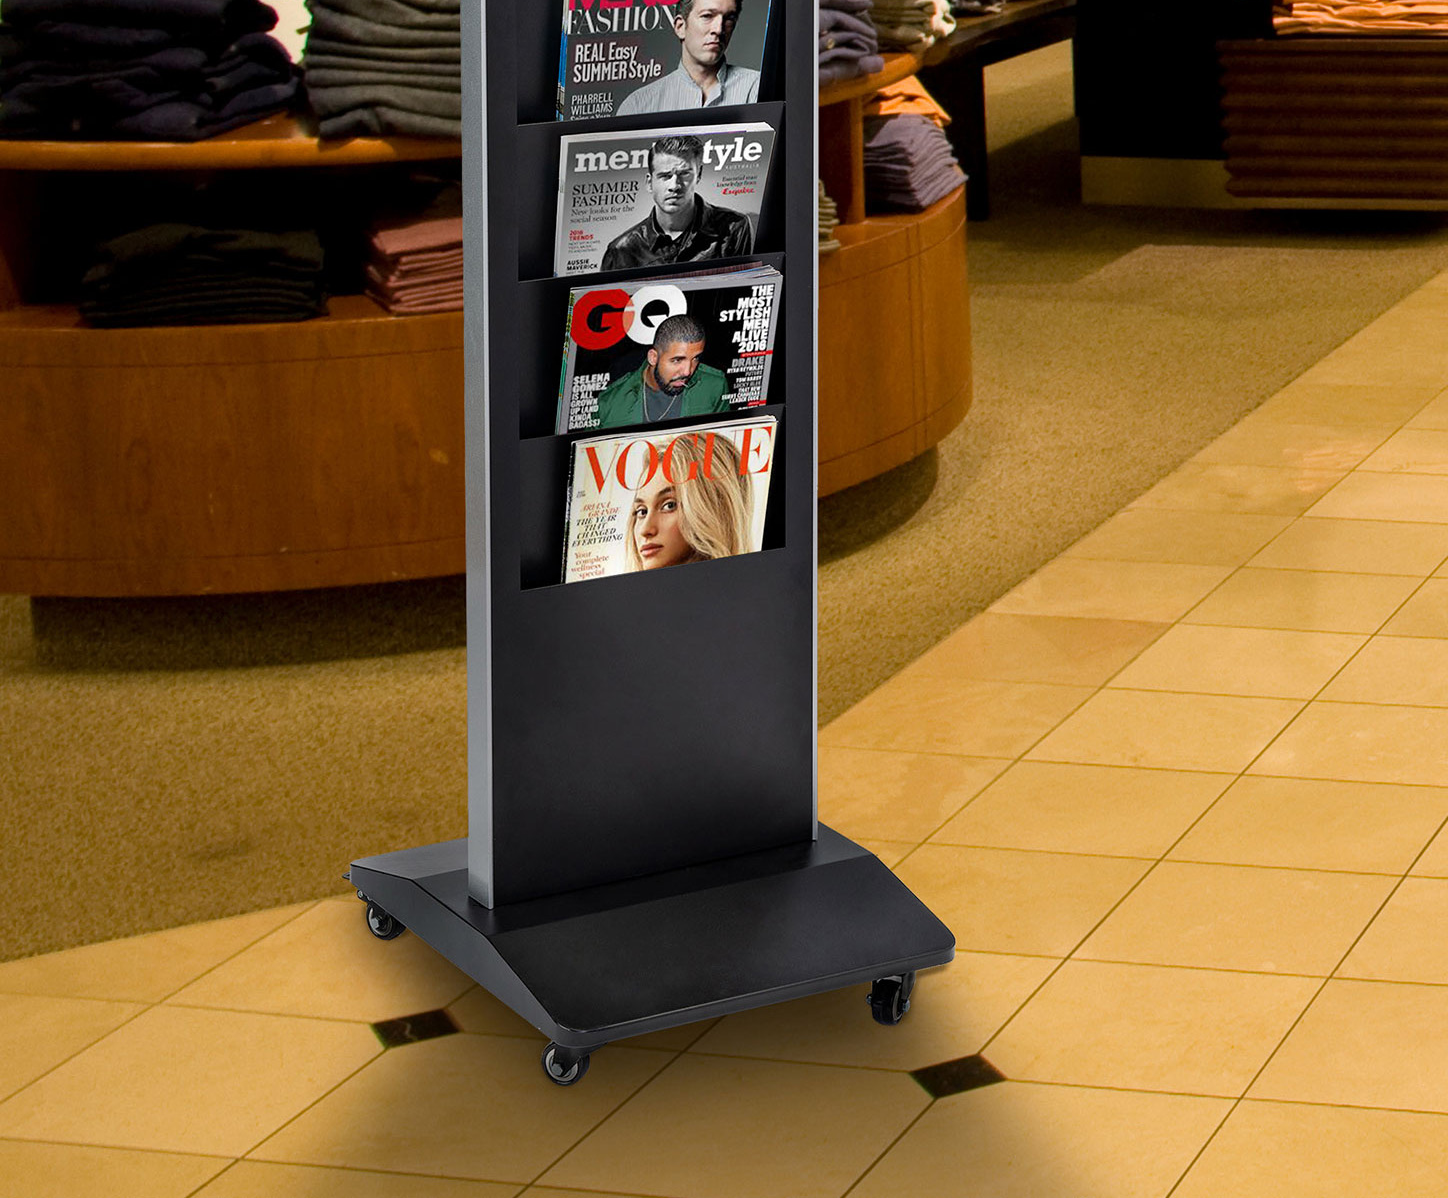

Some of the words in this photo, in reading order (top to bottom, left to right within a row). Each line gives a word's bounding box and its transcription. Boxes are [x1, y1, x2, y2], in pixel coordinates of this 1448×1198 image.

[567, 4, 678, 35] FASHION
[575, 42, 606, 63] REAL
[608, 42, 638, 62] Easy
[573, 61, 628, 83] SUMMER
[628, 59, 662, 83] Style
[571, 92, 614, 105] PHARRELL
[570, 103, 614, 116] WILLIAMS
[574, 142, 656, 172] men
[702, 136, 763, 171] tyle
[572, 180, 639, 196] SUMMER
[572, 192, 637, 208] FASHION
[566, 263, 599, 271] MAVERICK
[751, 284, 774, 297] THE
[737, 295, 773, 310] MOST
[570, 285, 688, 350] GQ
[719, 306, 771, 322] STYLISH
[742, 317, 770, 331] MEN
[732, 328, 769, 343] ALIVE
[731, 356, 765, 368] DRAKE
[573, 372, 610, 385] SELENA
[572, 381, 608, 393] GOMEZ
[571, 392, 579, 400] IS
[580, 391, 593, 399] ALL
[570, 398, 598, 408] GROWN
[570, 406, 581, 415] UP
[570, 413, 592, 422] KINDA
[581, 426, 773, 495] VOGUE
[572, 533, 623, 548] EVERYTHING
[576, 528, 617, 540] CHANGED
